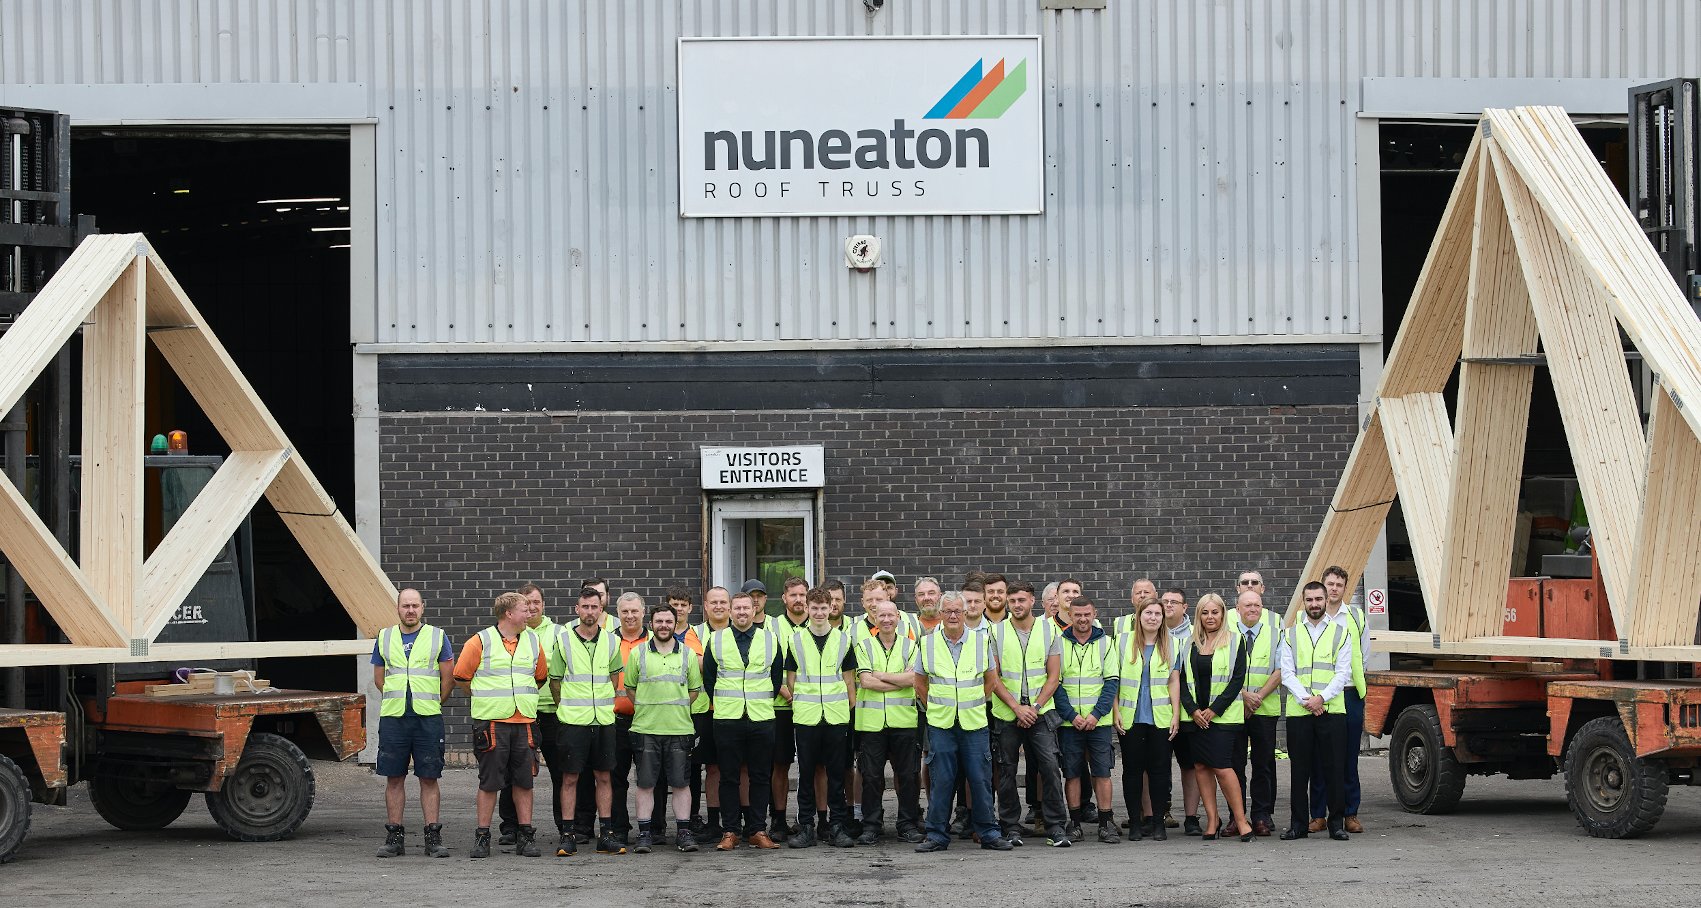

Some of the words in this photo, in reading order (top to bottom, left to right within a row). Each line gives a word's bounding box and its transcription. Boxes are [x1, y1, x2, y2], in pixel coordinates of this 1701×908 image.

[704, 118, 990, 171] nuneaton
[704, 182, 791, 199] ROOF
[818, 180, 925, 198] TRUSS
[726, 452, 801, 467] VISITORS
[720, 469, 808, 483] ENTRANCE
